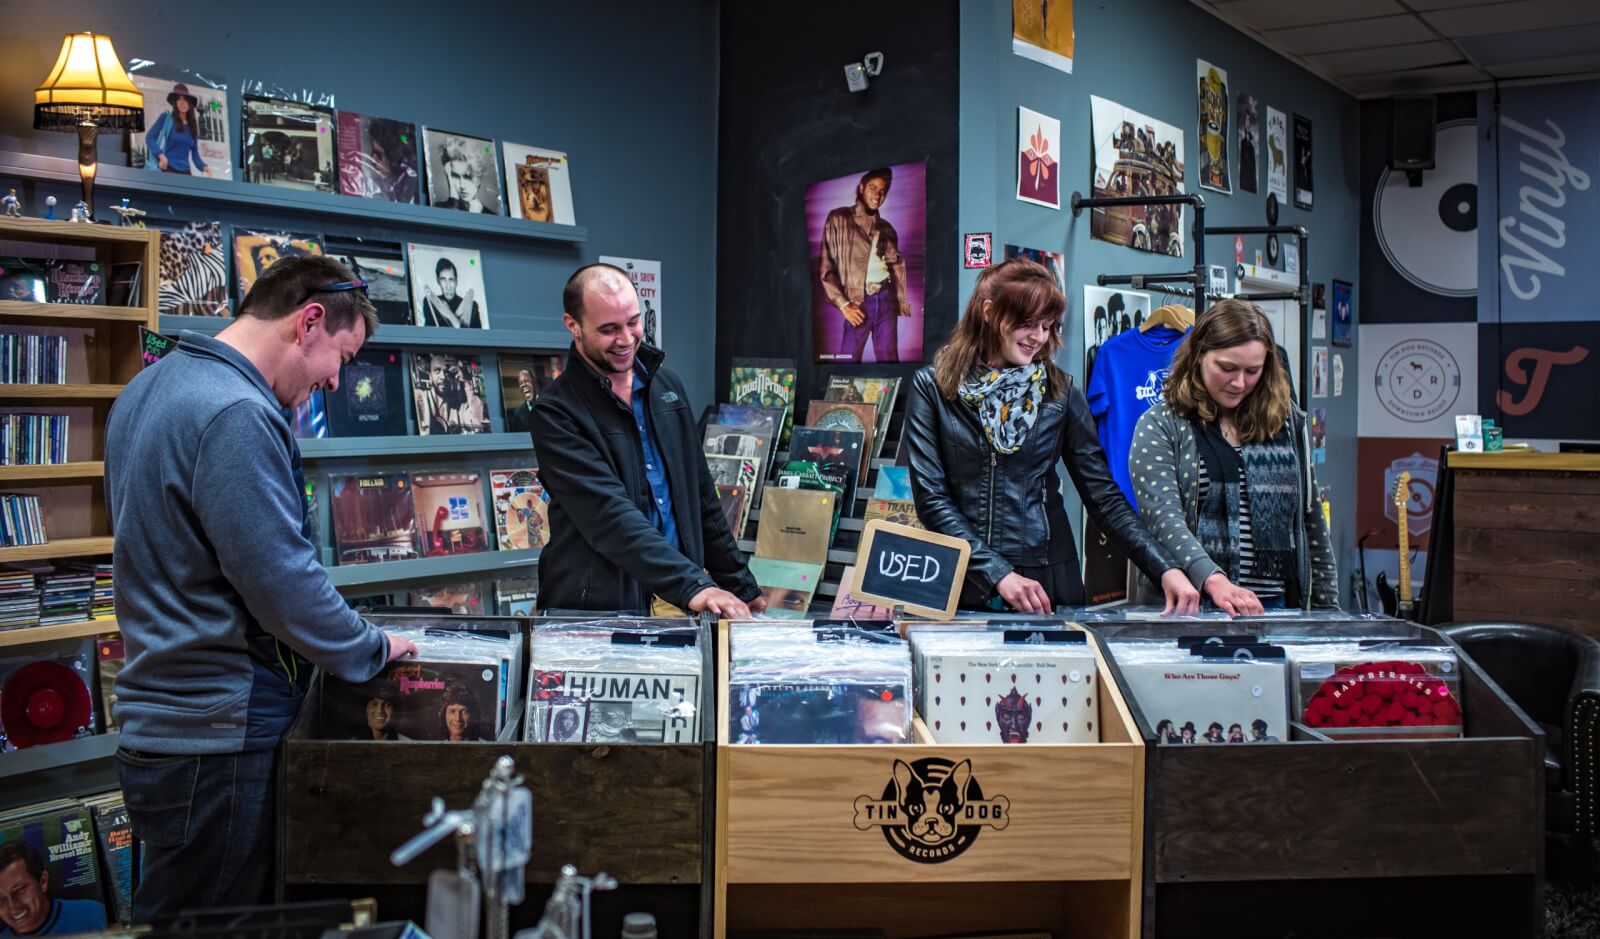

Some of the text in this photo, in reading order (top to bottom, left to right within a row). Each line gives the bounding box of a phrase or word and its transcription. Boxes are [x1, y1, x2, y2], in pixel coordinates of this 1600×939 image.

[1500, 115, 1591, 300] Vinyl
[640, 288, 656, 298] CITY
[146, 333, 168, 349] Used
[1396, 375, 1438, 385] T R
[1496, 345, 1590, 416] T
[1413, 389, 1422, 399] D
[879, 551, 941, 582] USED
[1219, 673, 1241, 681] Guys?
[1333, 671, 1432, 698] RASPBERRIES
[569, 676, 671, 700] HUMAN
[865, 804, 1002, 819] TIN DOG
[65, 830, 90, 844] Andy
[76, 846, 92, 856] Hits
[909, 843, 955, 858] RECORDS
